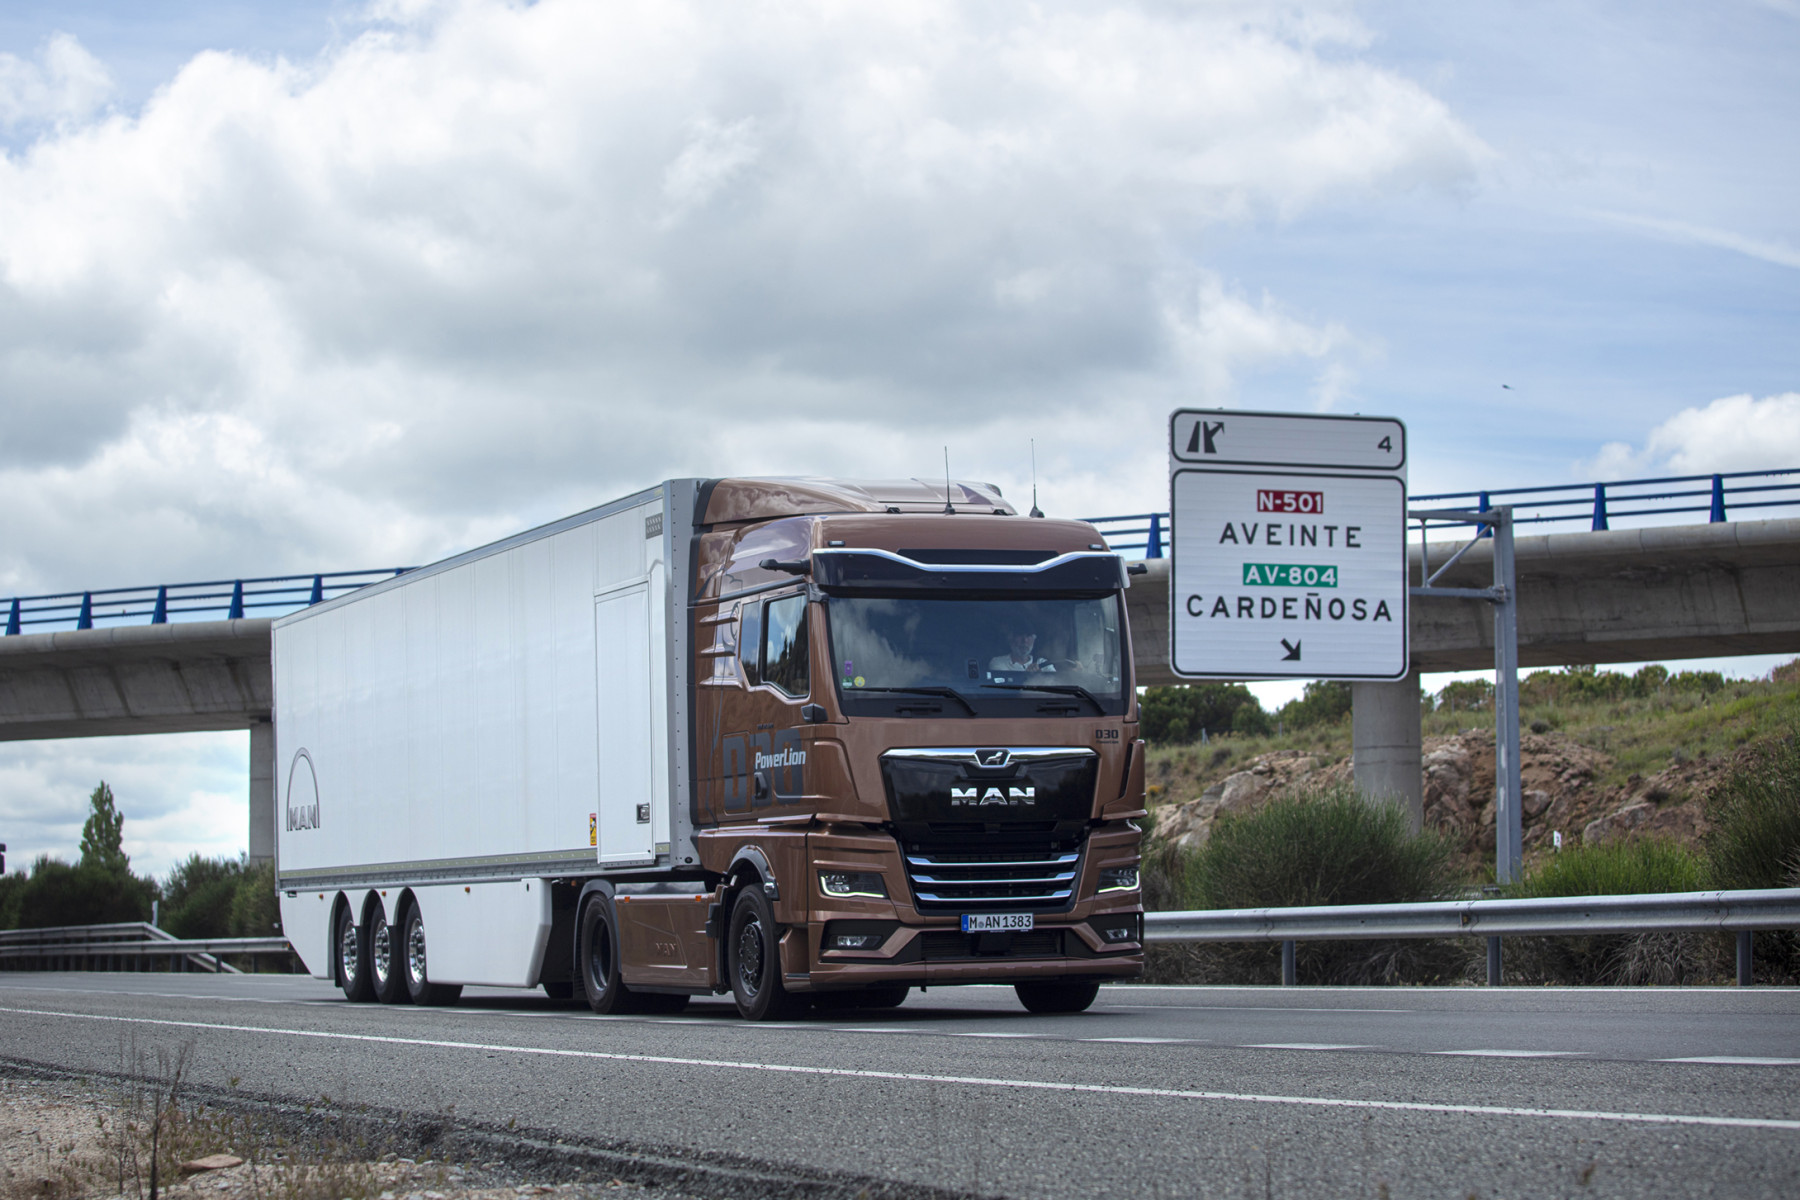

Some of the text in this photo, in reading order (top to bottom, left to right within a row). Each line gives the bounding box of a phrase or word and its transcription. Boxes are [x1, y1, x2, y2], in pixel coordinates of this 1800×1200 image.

[1377, 436, 1392, 453] 4
[1258, 491, 1322, 513] N-501
[1219, 522, 1361, 548] AVEINTE
[1245, 565, 1336, 586] AV-804
[1186, 593, 1392, 622] CARDEÑOSA
[755, 747, 807, 770] PowerLion
[951, 787, 1036, 806] MAN
[289, 804, 317, 831] MAN
[1002, 915, 1032, 928] 1383
